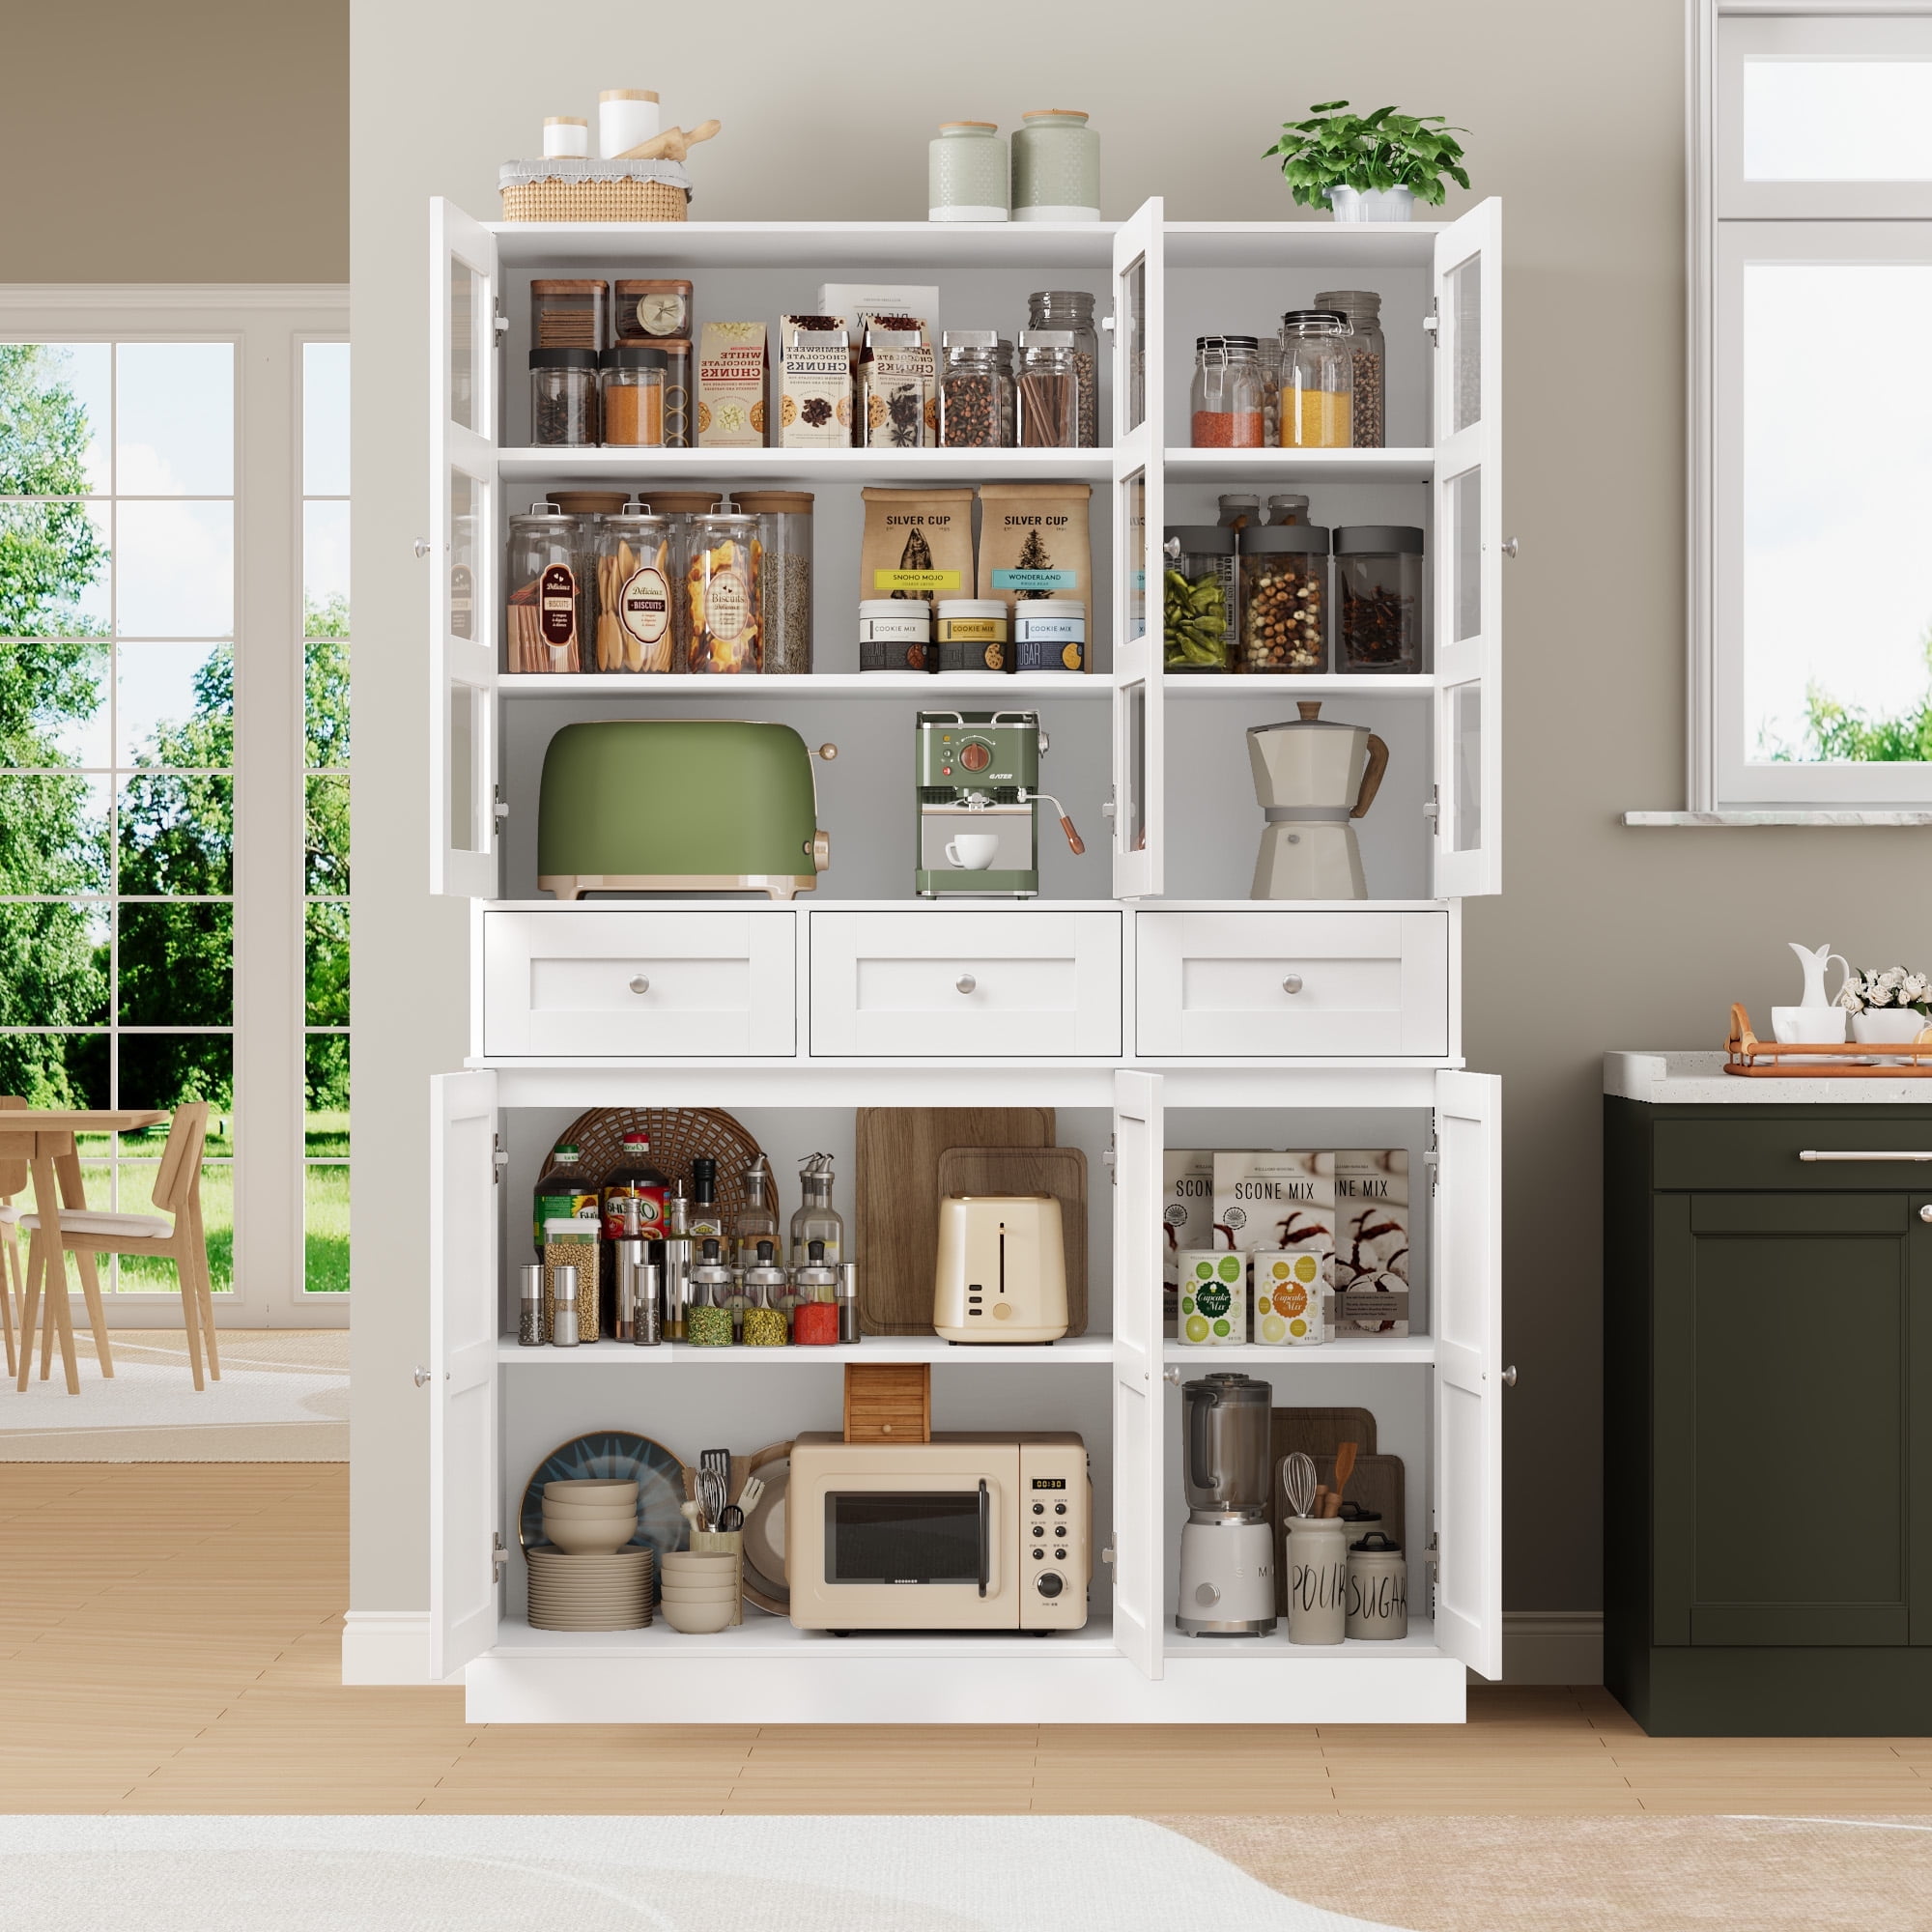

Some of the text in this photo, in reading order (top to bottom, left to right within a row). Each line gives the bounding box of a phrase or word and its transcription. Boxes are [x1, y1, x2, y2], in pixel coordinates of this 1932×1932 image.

[887, 516, 951, 526] SILVER CUP
[1005, 516, 1068, 526] SILVER CUP
[712, 593, 745, 603] Biscuits
[634, 601, 662, 610] BISCUITS
[1017, 642, 1040, 666] UGAR
[1176, 1179, 1213, 1197] SCON
[1235, 1181, 1282, 1200] SCONE
[1289, 1181, 1315, 1200] MIX
[1363, 1179, 1388, 1197] MIX
[1197, 1293, 1229, 1303] Cupcake
[1274, 1293, 1306, 1303] Cupcake
[1209, 1301, 1226, 1311] Mix
[1286, 1301, 1302, 1311] Mix
[1293, 1561, 1346, 1612] POUR
